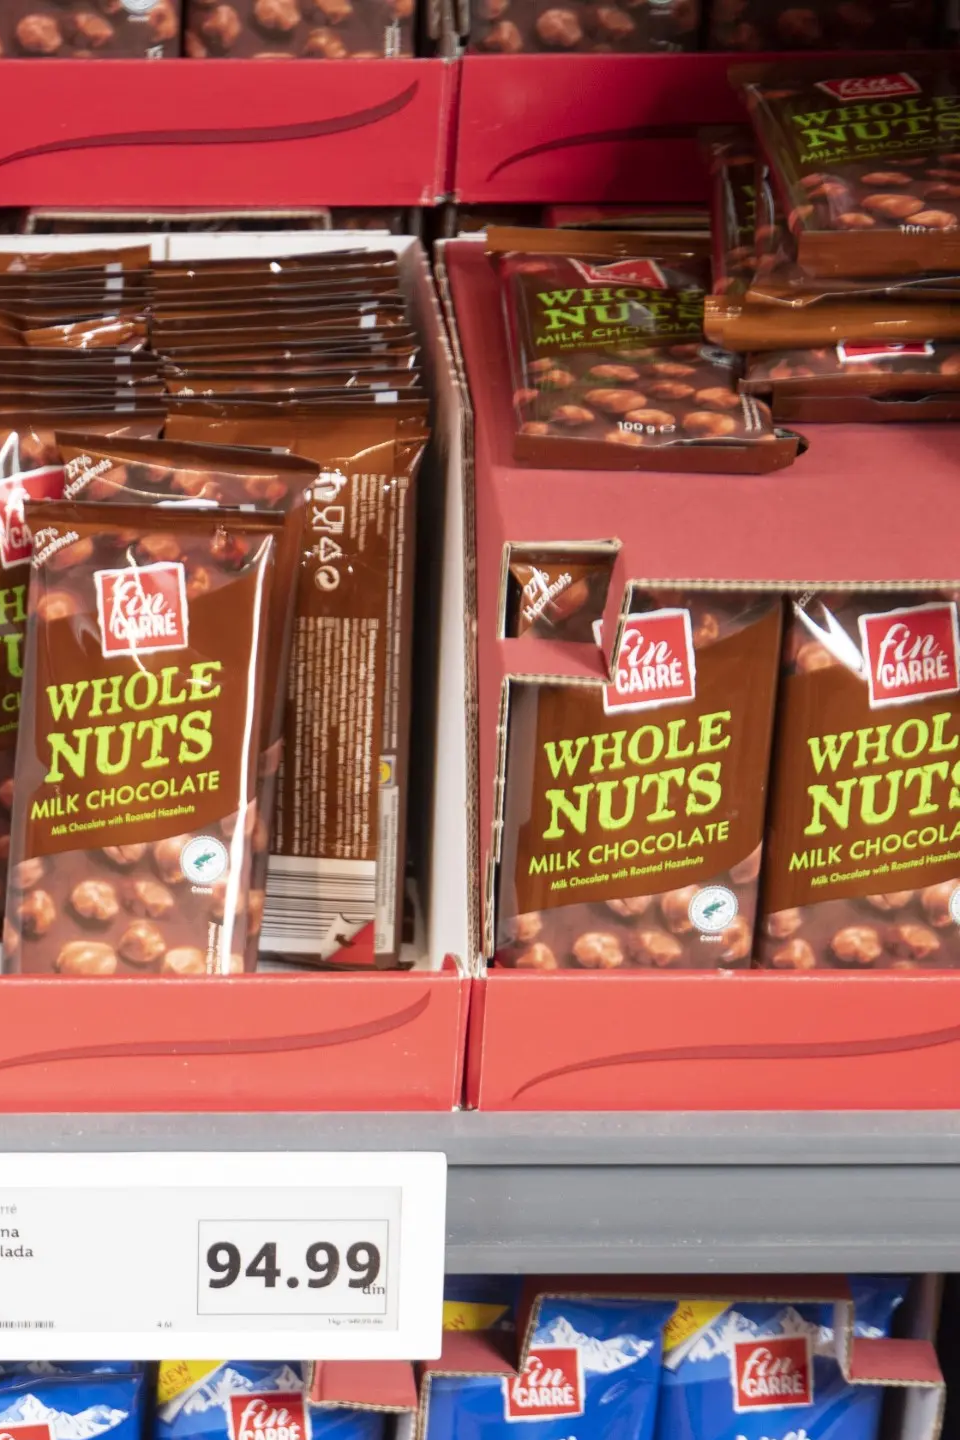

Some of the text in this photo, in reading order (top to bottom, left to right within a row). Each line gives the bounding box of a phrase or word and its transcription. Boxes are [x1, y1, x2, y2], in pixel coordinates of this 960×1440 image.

[535, 331, 584, 347] MILK
[617, 421, 643, 432] 100
[879, 624, 940, 682] fin
[615, 656, 683, 693] CARRÉ
[882, 655, 949, 689] CARRÉ
[46, 661, 222, 721] WHOLE
[45, 710, 212, 783] NUTS
[544, 711, 731, 778] WHOLE
[808, 714, 958, 774] WHOL
[30, 771, 219, 820] MILK CHOCOLATE
[542, 762, 721, 839] NUTS
[51, 826, 67, 836] Milk
[69, 819, 106, 833] Chocolate
[108, 815, 123, 825] with
[126, 810, 156, 824] Roasted
[529, 821, 729, 874] MILK CHOCOLATE
[789, 845, 842, 871] MILK
[551, 879, 567, 890] Milk
[570, 872, 609, 887] Chocolate
[612, 868, 628, 879] with
[631, 861, 662, 876] Roasted
[812, 858, 924, 887] Milk Chocolate with Roasted
[207, 1241, 380, 1289] 94.99
[362, 1284, 385, 1295] din
[743, 1348, 795, 1395] fin
[746, 1371, 803, 1397] CARRÉ
[515, 1383, 574, 1408] CARRÉ
